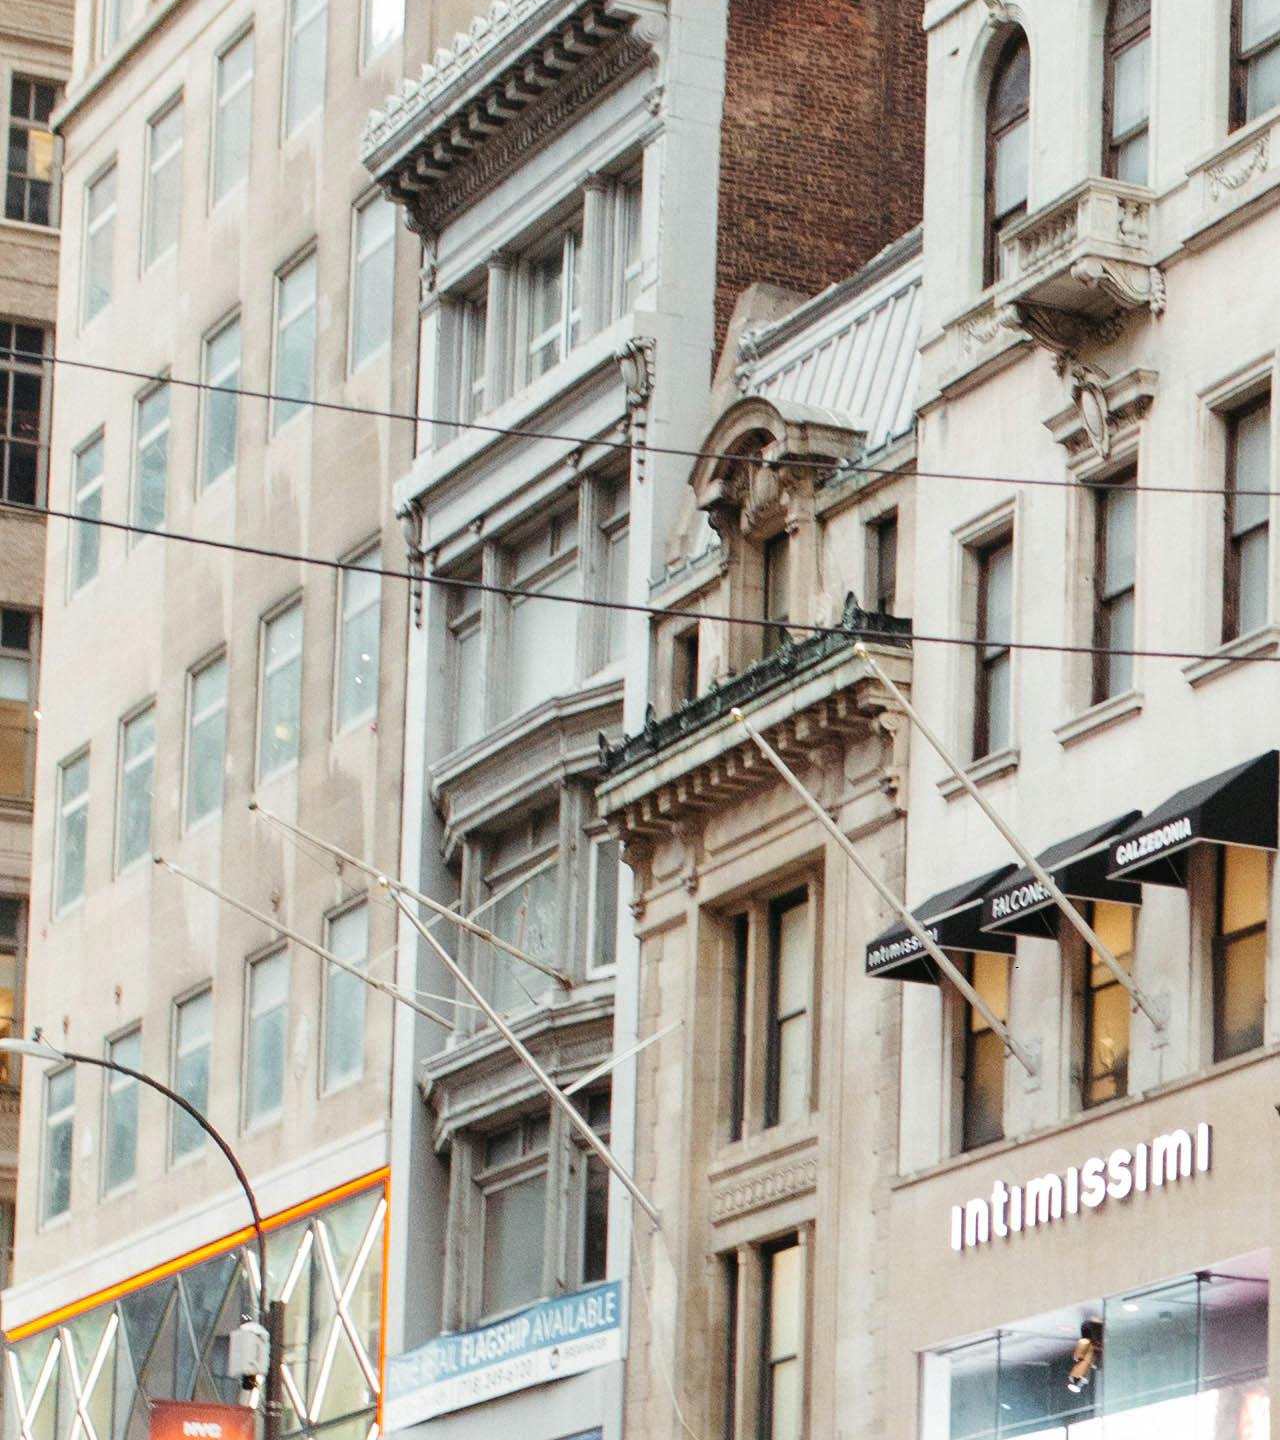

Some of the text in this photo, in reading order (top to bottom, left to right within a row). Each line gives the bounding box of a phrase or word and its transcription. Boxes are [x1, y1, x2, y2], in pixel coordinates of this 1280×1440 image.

[1116, 817, 1192, 865] CALZEDONIA
[992, 875, 1055, 919] FALCONE
[868, 928, 939, 967] intimissi
[951, 1122, 1209, 1251] intimissimi
[460, 1317, 531, 1367] FLAGSHIP
[531, 1291, 616, 1345] AVAILABLE
